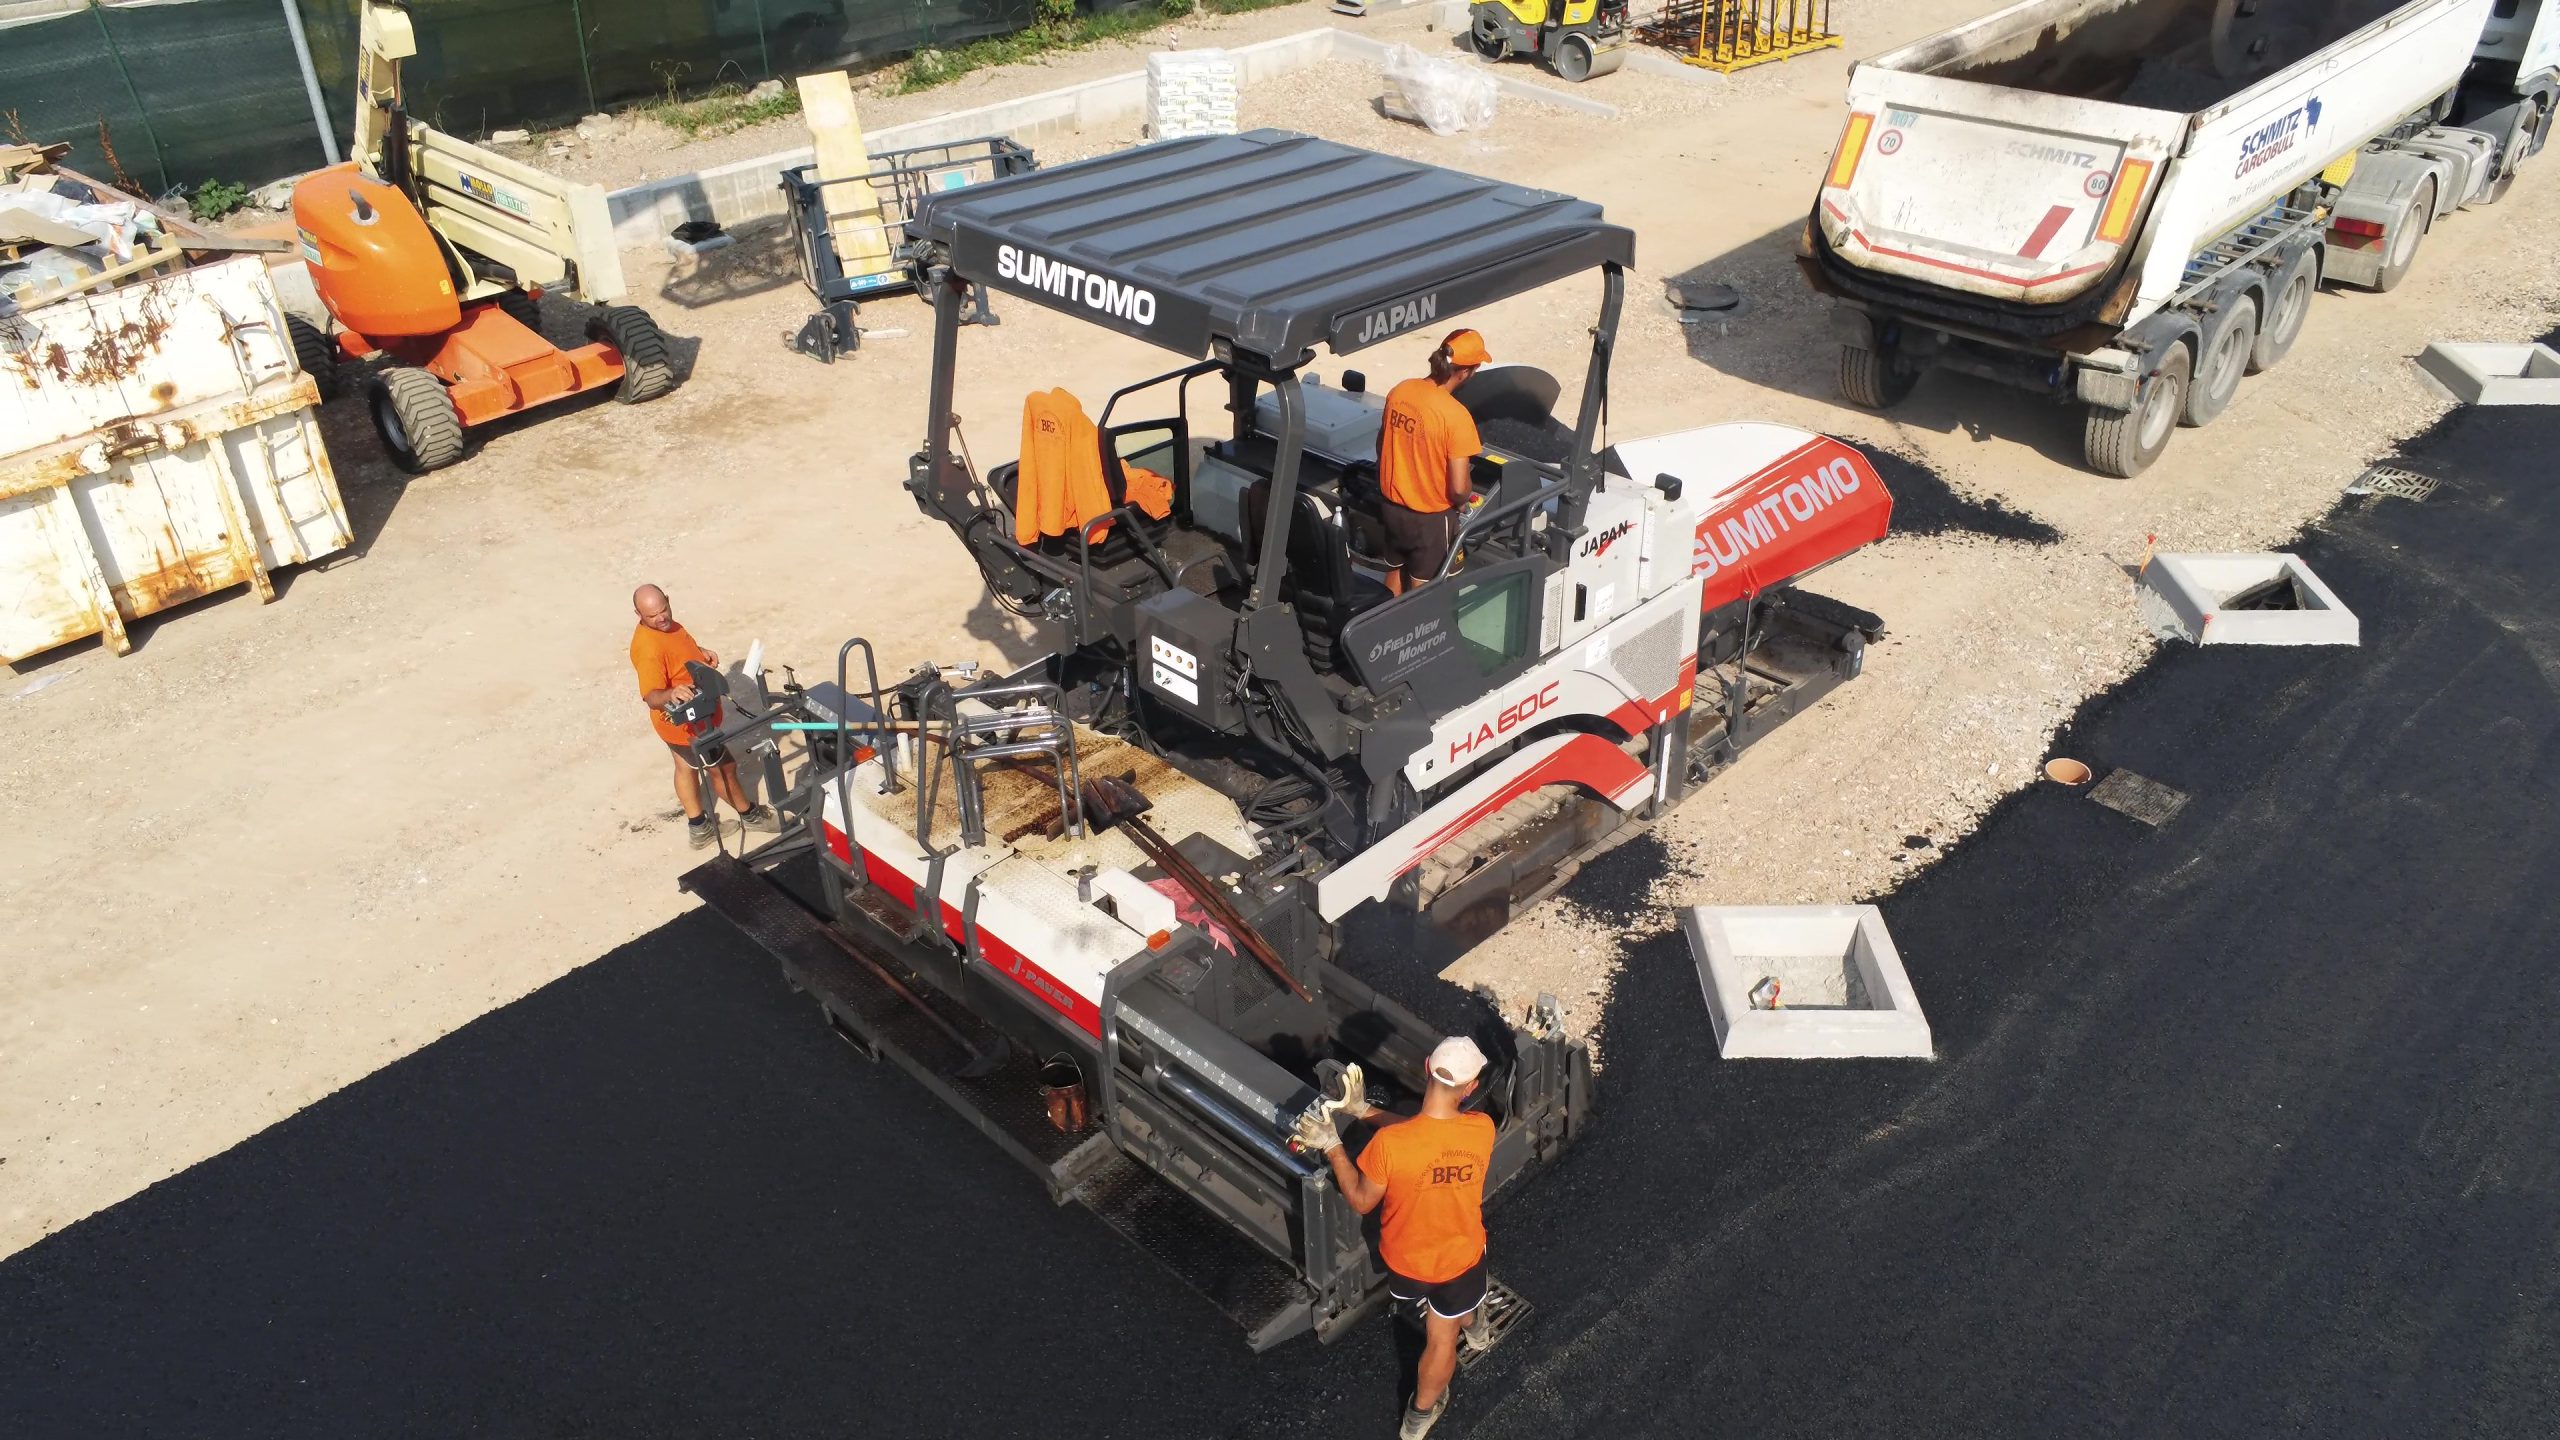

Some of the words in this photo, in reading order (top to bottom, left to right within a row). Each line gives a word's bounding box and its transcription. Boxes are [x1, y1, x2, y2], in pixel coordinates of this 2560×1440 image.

[1884, 136, 1897, 148] 70
[2239, 107, 2303, 161] SCHMITZ
[2004, 140, 2097, 169] SCHMITZ
[2235, 132, 2296, 180] CARGOBULL
[2090, 178, 2106, 190] 80
[997, 244, 1156, 326] SUMITOMO
[1358, 293, 1437, 344] JAPAN
[1390, 409, 1416, 434] BFG
[1692, 457, 1861, 579] SUMITOMO
[1580, 520, 1629, 558] JAPAN
[1382, 632, 1414, 656] FIELD
[1414, 618, 1440, 640] VIEW
[1398, 631, 1447, 665] MONITOR
[1450, 680, 1559, 764] HA60C
[1431, 1164, 1473, 1185] BFG
